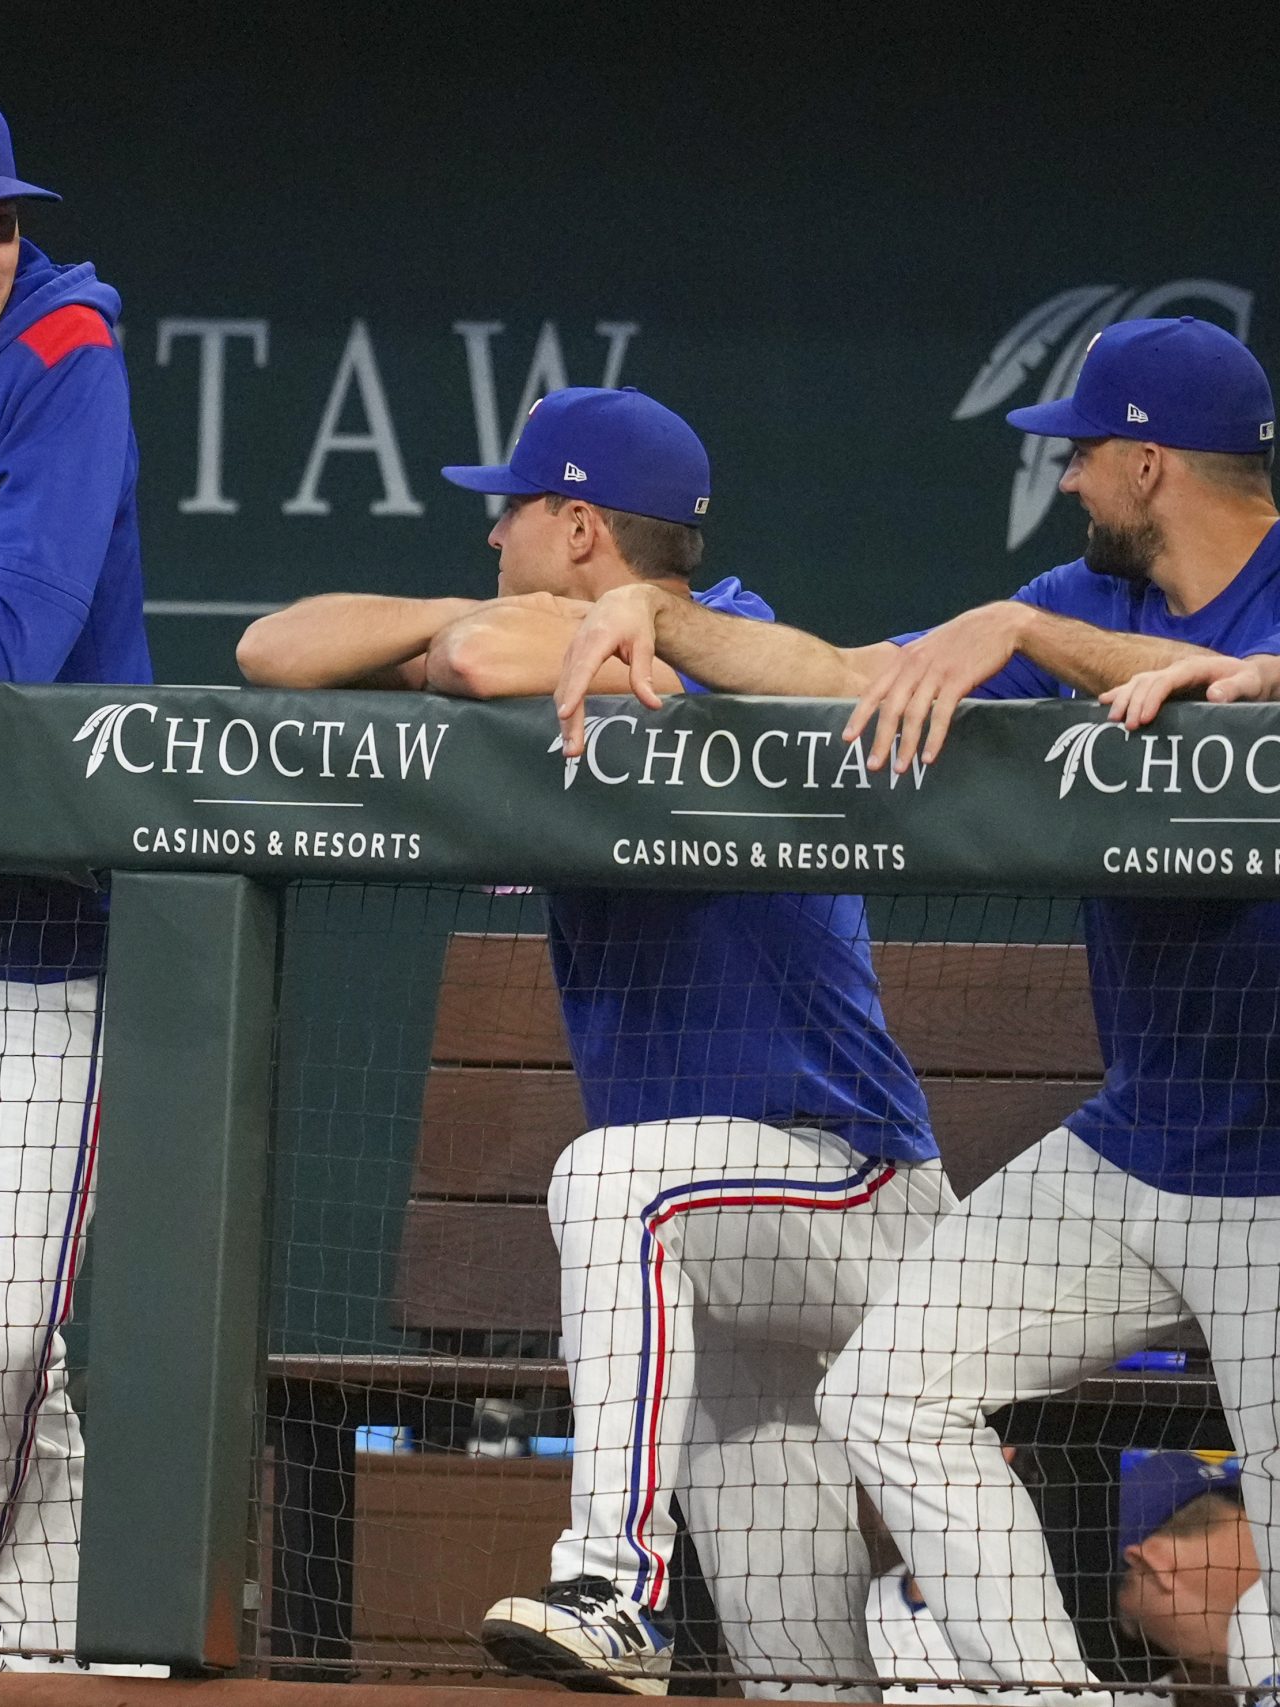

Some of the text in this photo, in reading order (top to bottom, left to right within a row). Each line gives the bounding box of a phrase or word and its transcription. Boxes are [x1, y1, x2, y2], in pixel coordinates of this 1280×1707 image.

[114, 702, 449, 780] CHOCTAW
[133, 827, 420, 859] CASINOS & RESORTS
[613, 839, 904, 870] CASINOS & RESORTS
[1104, 847, 1233, 874] CASINOS
[1246, 848, 1262, 874] &
